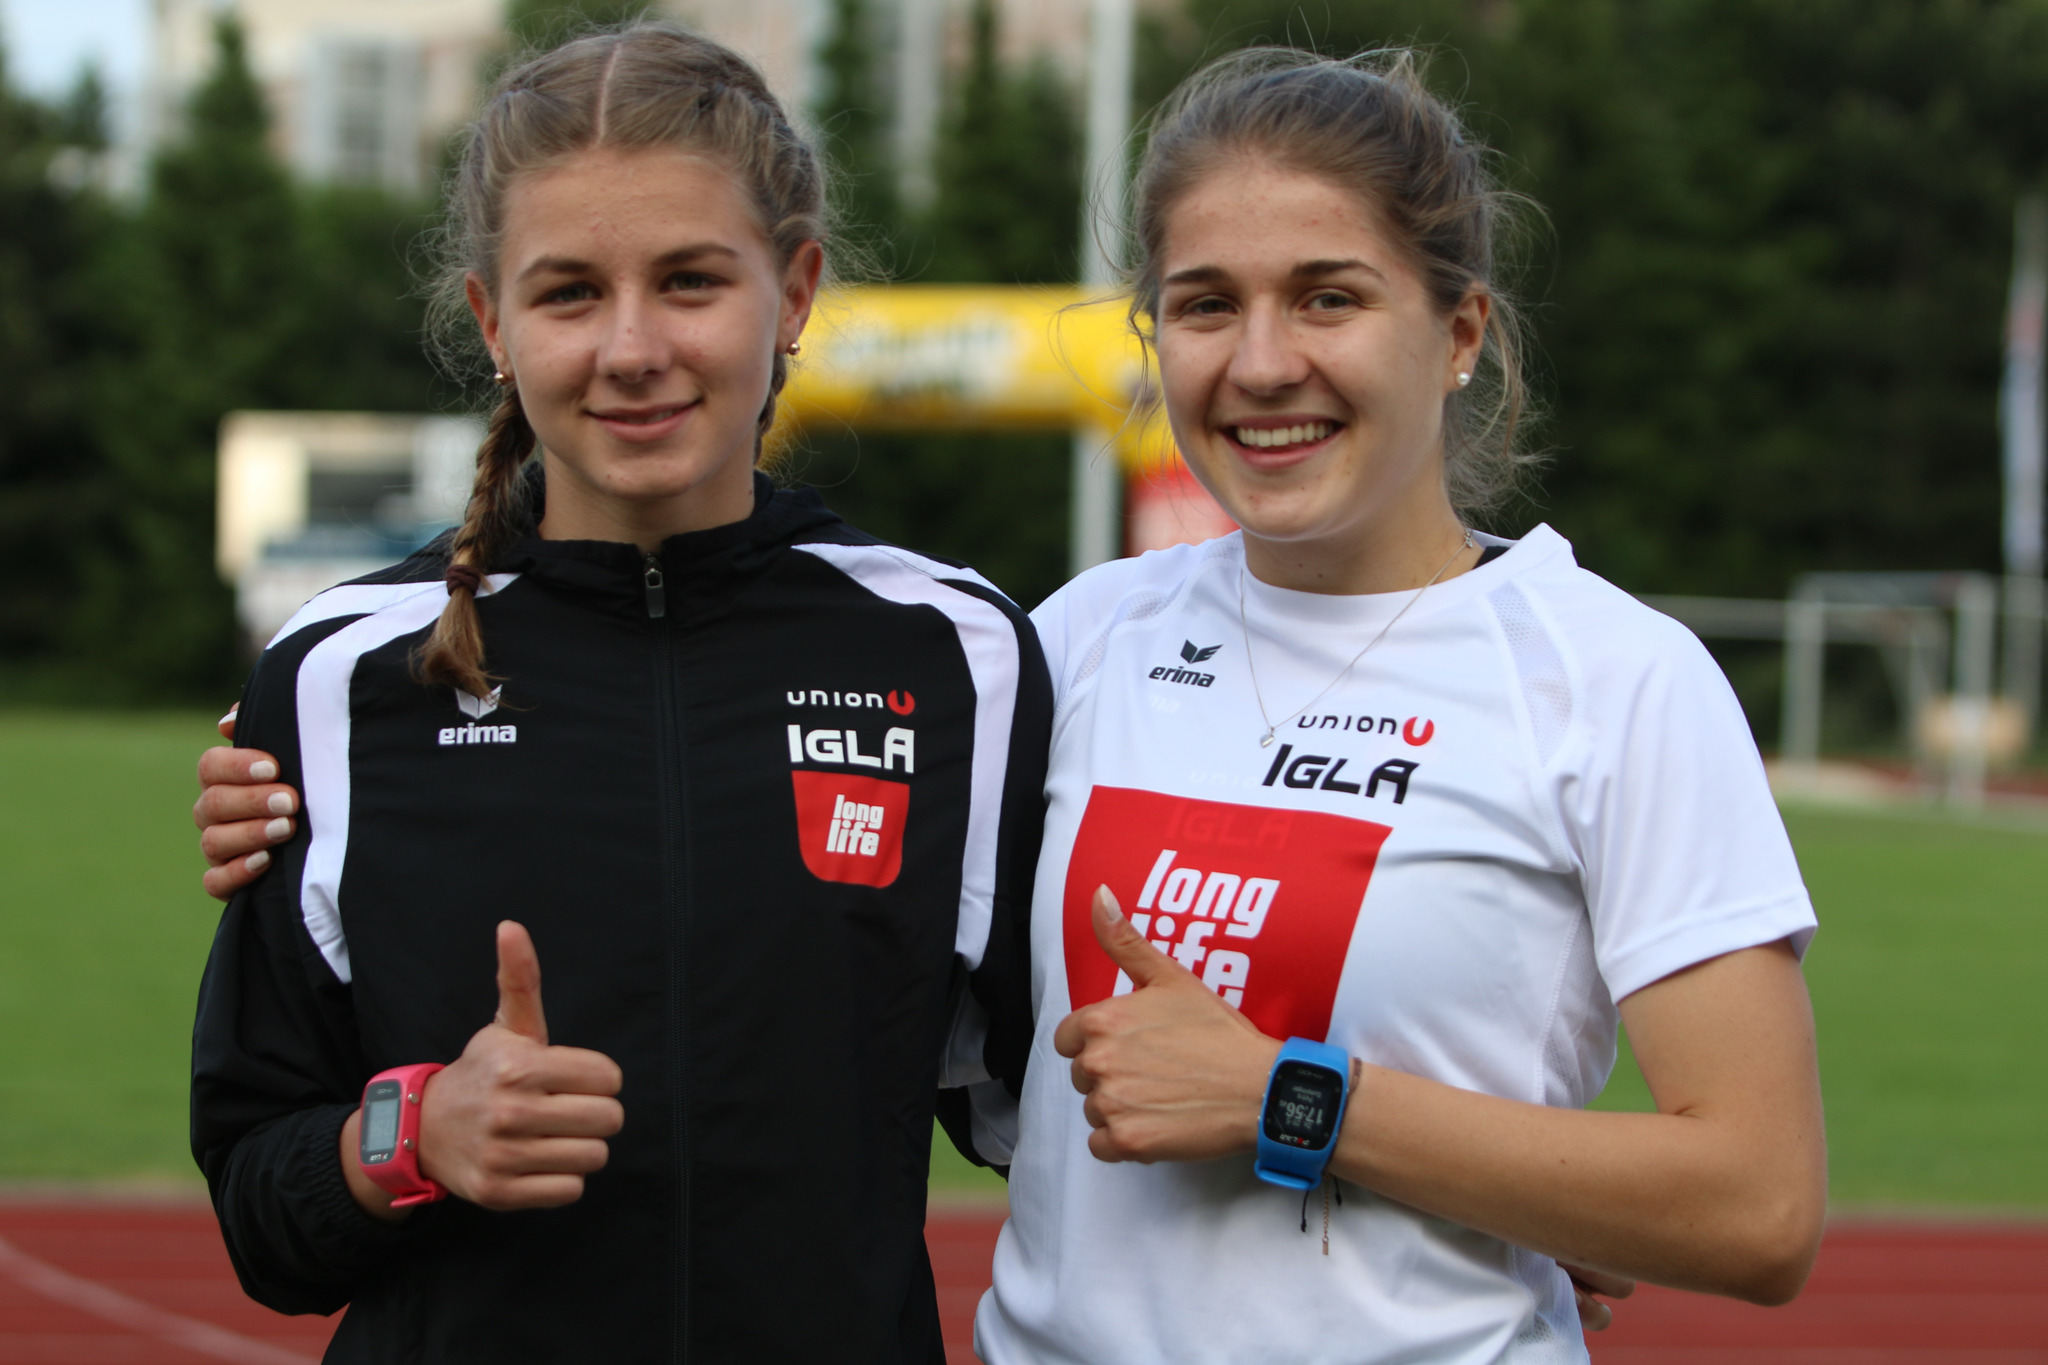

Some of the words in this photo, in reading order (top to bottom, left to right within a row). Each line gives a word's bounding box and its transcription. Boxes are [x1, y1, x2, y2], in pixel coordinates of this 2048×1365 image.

[1148, 666, 1216, 688] erima
[438, 722, 517, 745] erima
[787, 724, 914, 773] IGLA
[1262, 744, 1419, 804] IGLA
[832, 794, 884, 829] long
[826, 819, 881, 856] life
[1136, 848, 1280, 939] long
[1112, 912, 1250, 1010] fe
[1286, 1102, 1324, 1125] 17:56
